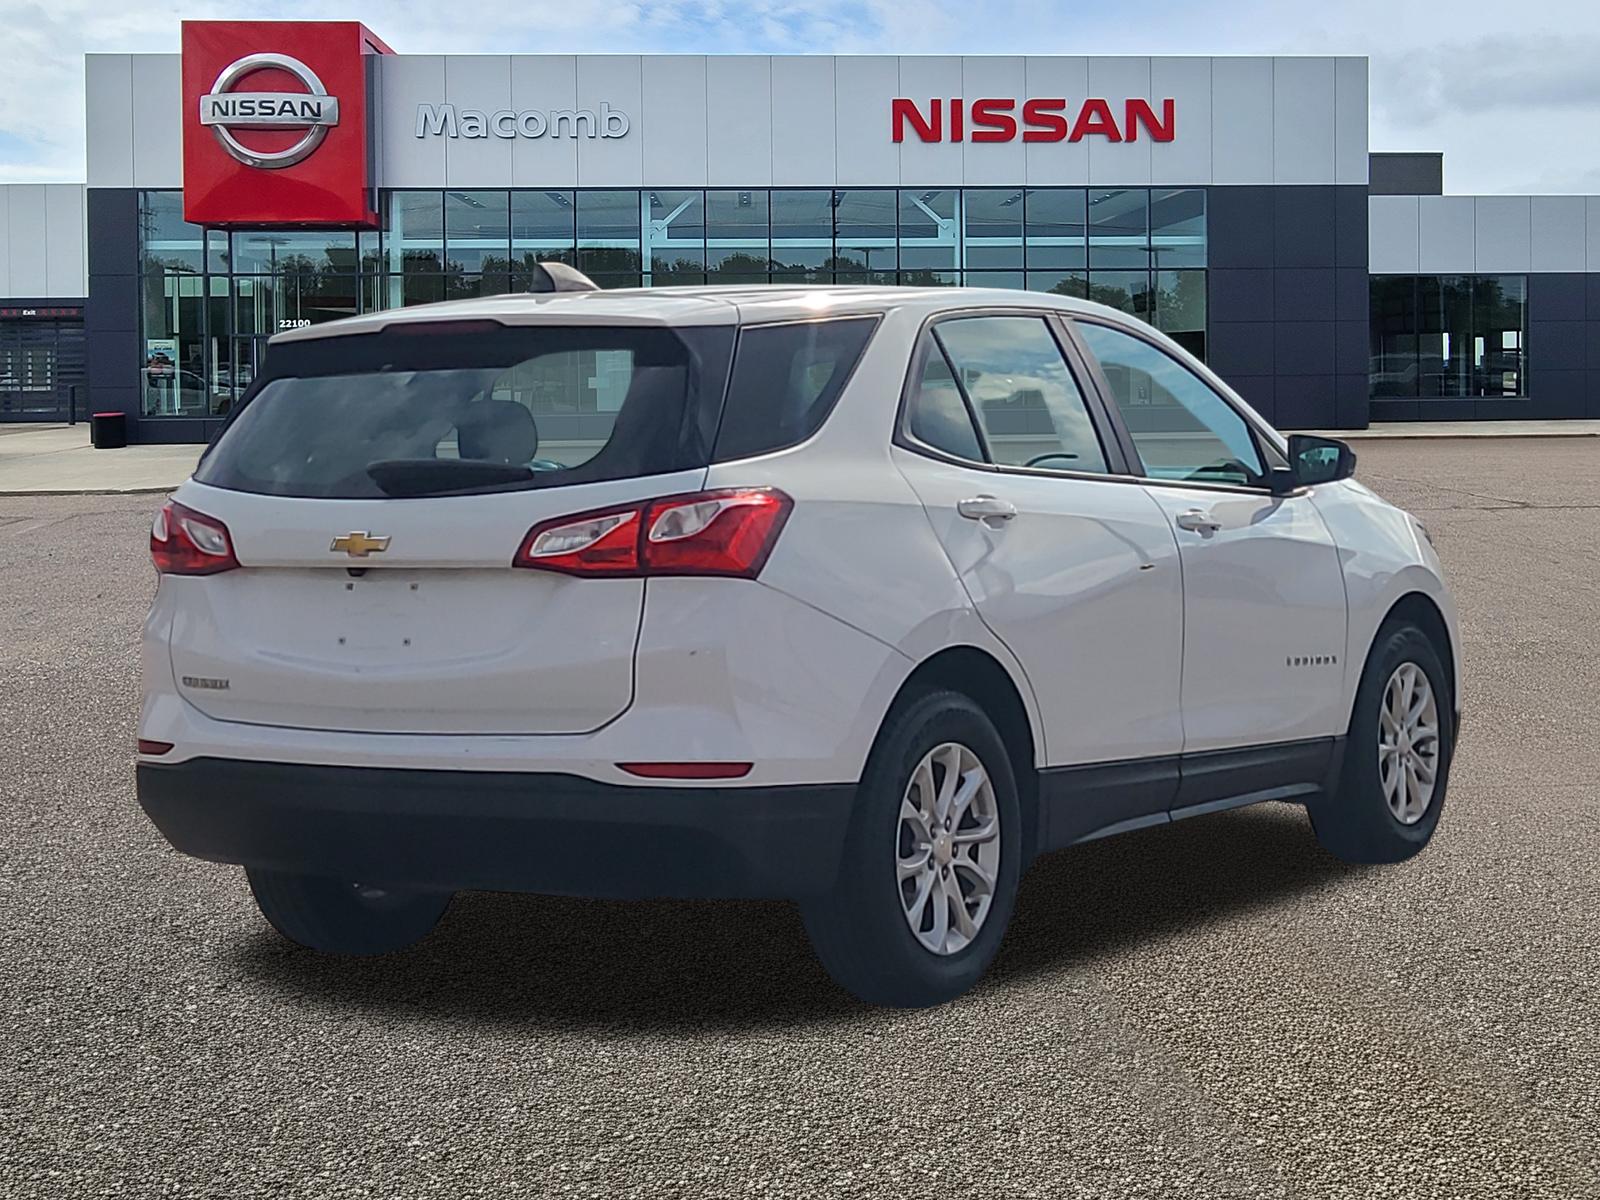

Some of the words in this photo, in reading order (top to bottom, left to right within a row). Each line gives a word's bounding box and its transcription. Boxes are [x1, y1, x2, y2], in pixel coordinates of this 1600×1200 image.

[211, 100, 321, 117] NISSAN
[415, 102, 630, 138] Macomb
[892, 98, 1175, 142] NISSAN
[279, 319, 311, 328] 22100
